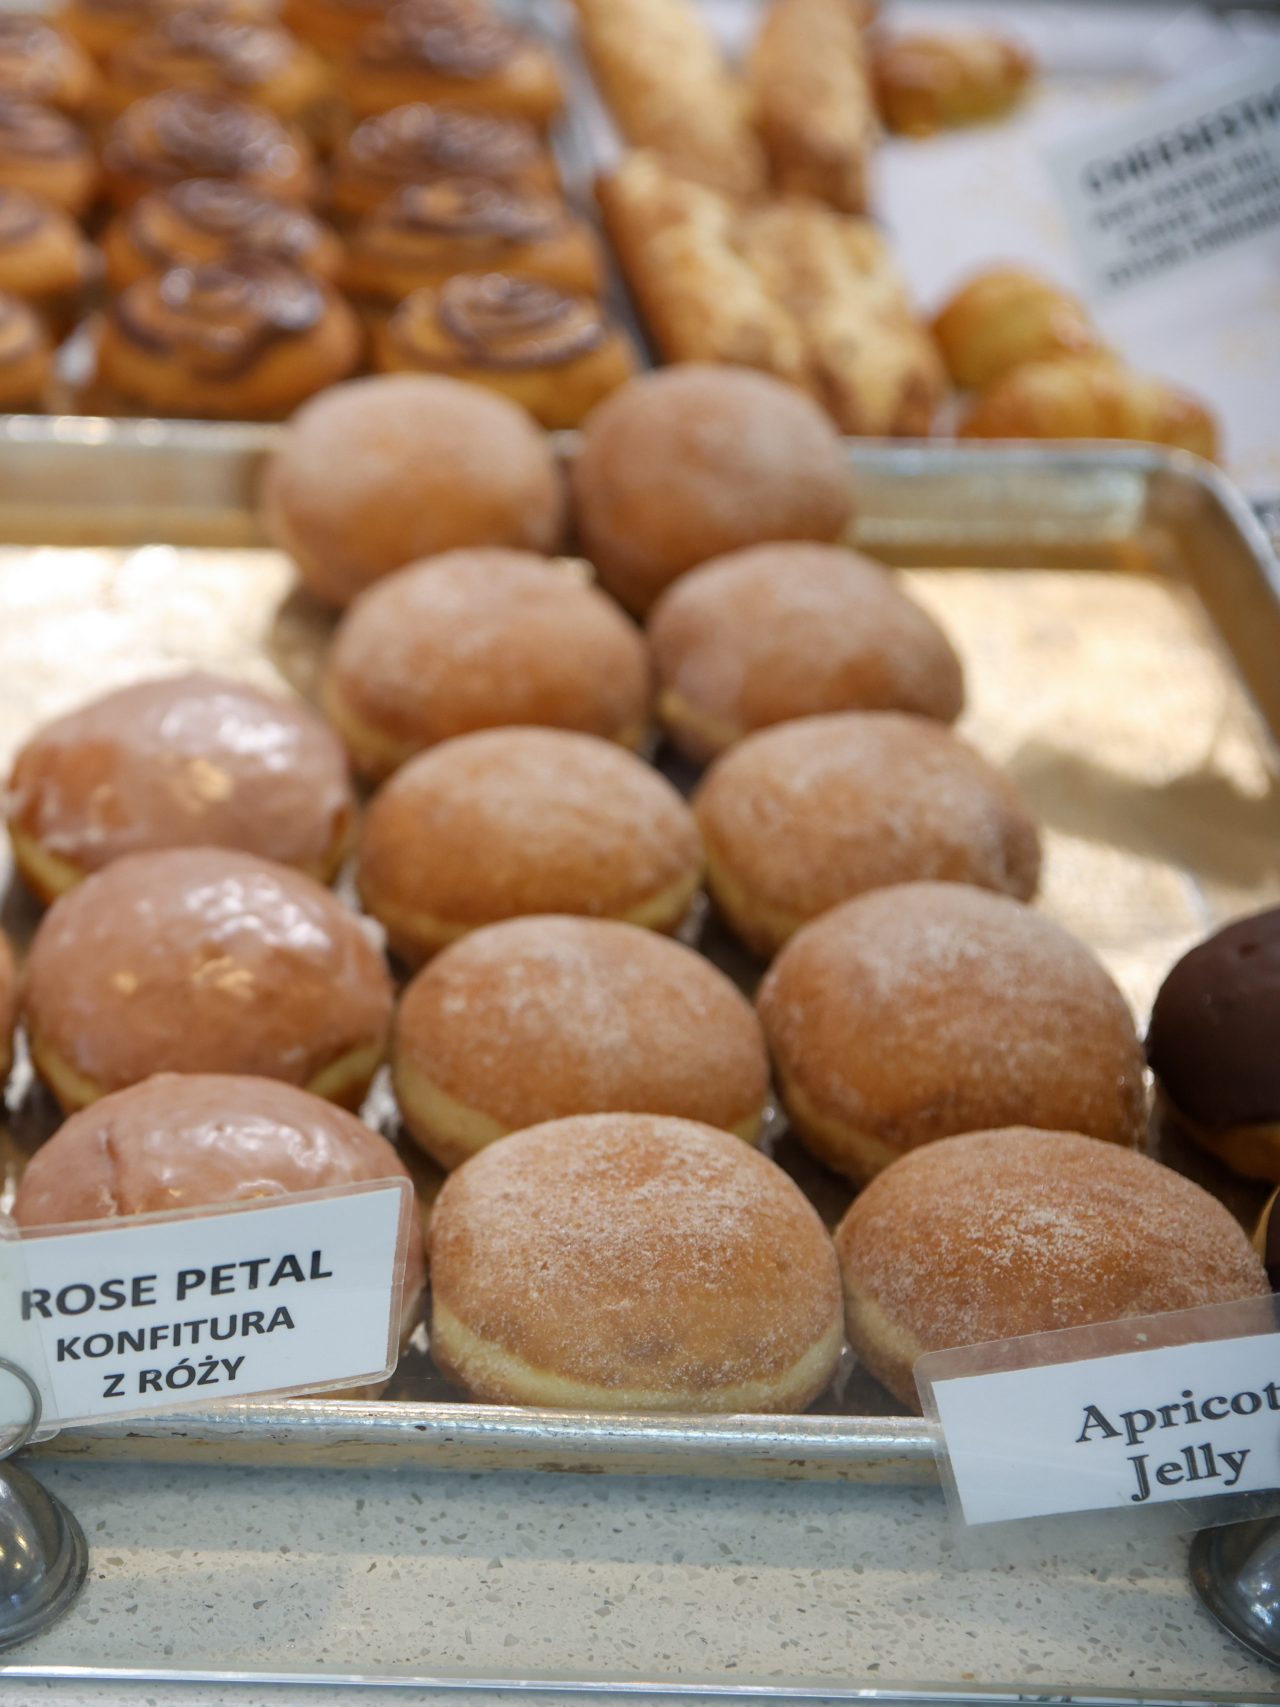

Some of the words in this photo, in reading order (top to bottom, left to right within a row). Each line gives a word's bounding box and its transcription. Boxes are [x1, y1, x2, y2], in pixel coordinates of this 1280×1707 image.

[21, 1275, 157, 1321] ROSE
[177, 1250, 333, 1301] PETAL
[57, 1306, 295, 1362] KONFITURA
[103, 1373, 125, 1398] Z
[139, 1355, 246, 1393] RÓŻY
[1075, 1382, 1280, 1446] Apricot
[1127, 1442, 1251, 1502] Jelly
